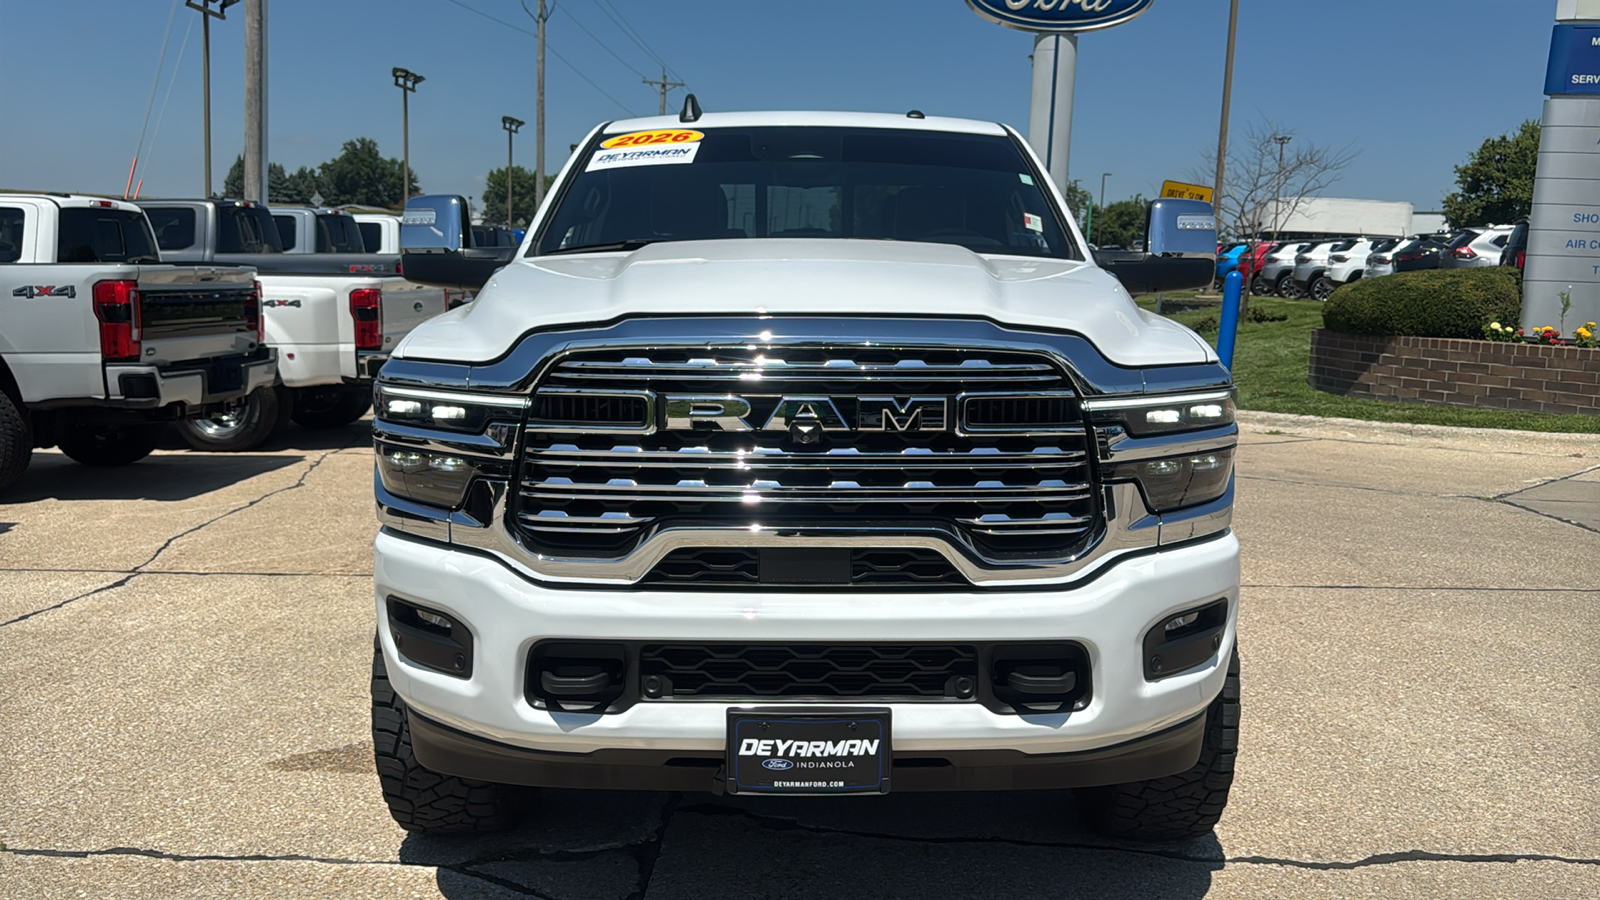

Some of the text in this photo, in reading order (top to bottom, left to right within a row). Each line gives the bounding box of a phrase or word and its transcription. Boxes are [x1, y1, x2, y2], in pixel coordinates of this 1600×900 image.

[613, 132, 693, 147] 2026
[598, 148, 692, 161] DEYARMAN
[1167, 189, 1185, 198] DRIVE
[1565, 239, 1587, 249] AIR
[665, 395, 948, 431] RAM
[738, 738, 879, 757] DEYARMAN
